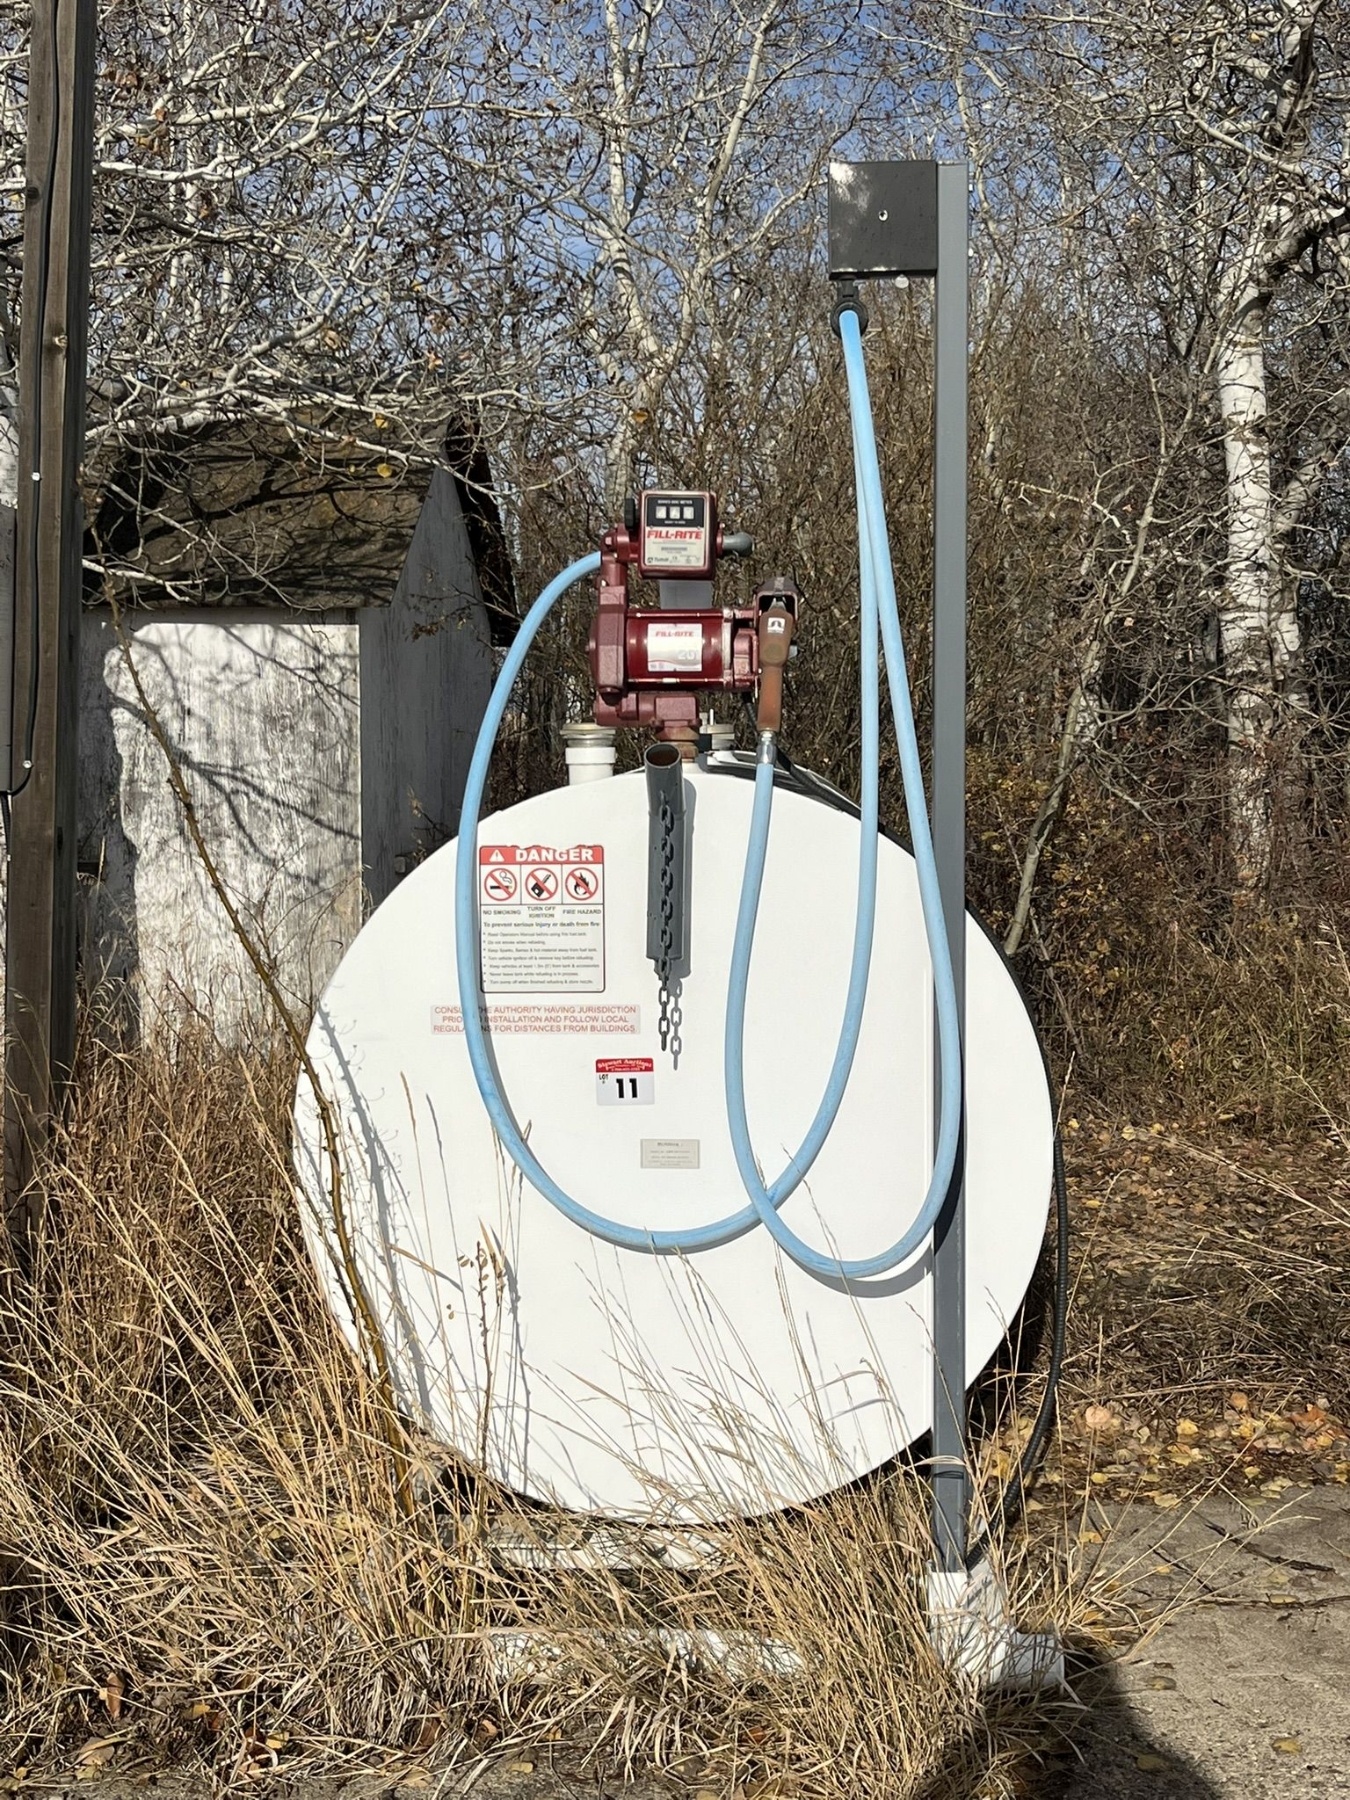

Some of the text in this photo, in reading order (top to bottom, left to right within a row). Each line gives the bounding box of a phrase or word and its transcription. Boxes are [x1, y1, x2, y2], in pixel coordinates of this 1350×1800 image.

[647, 530, 703, 539] FILL-RITE
[516, 849, 594, 862] DANGER
[616, 1078, 637, 1098] 11
